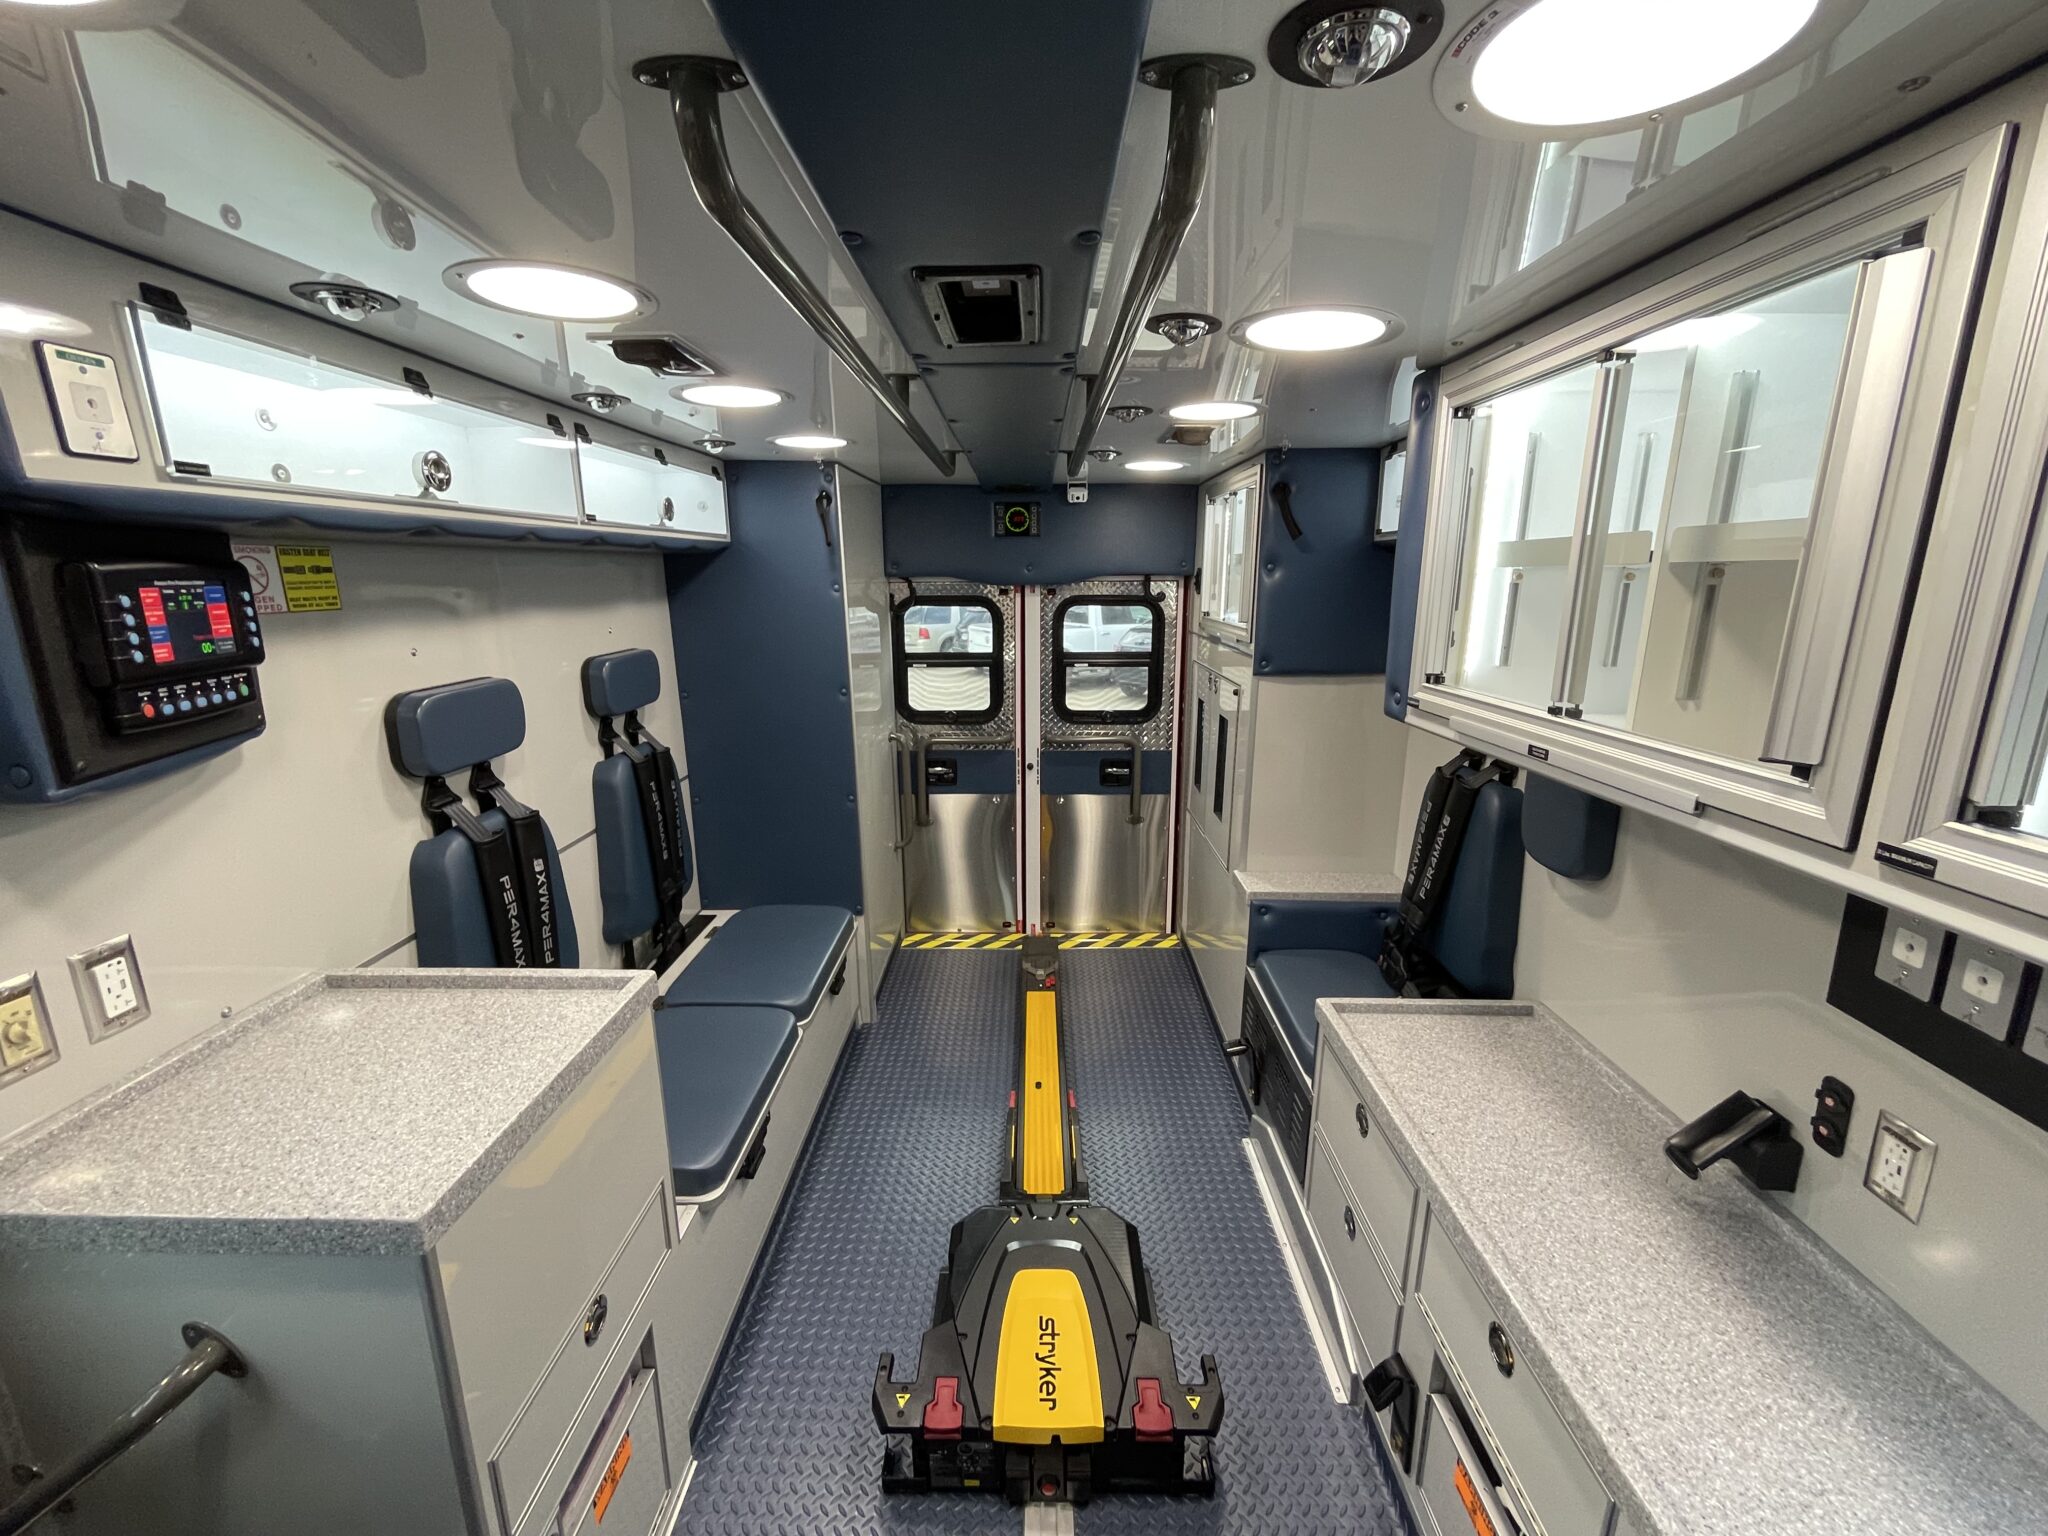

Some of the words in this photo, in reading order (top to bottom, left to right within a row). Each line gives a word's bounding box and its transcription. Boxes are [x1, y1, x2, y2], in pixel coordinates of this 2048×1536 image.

[1457, 19, 1488, 50] CODE
[255, 595, 275, 603] GEN
[257, 604, 283, 612] PPED
[1035, 1315, 1062, 1411] stryker
